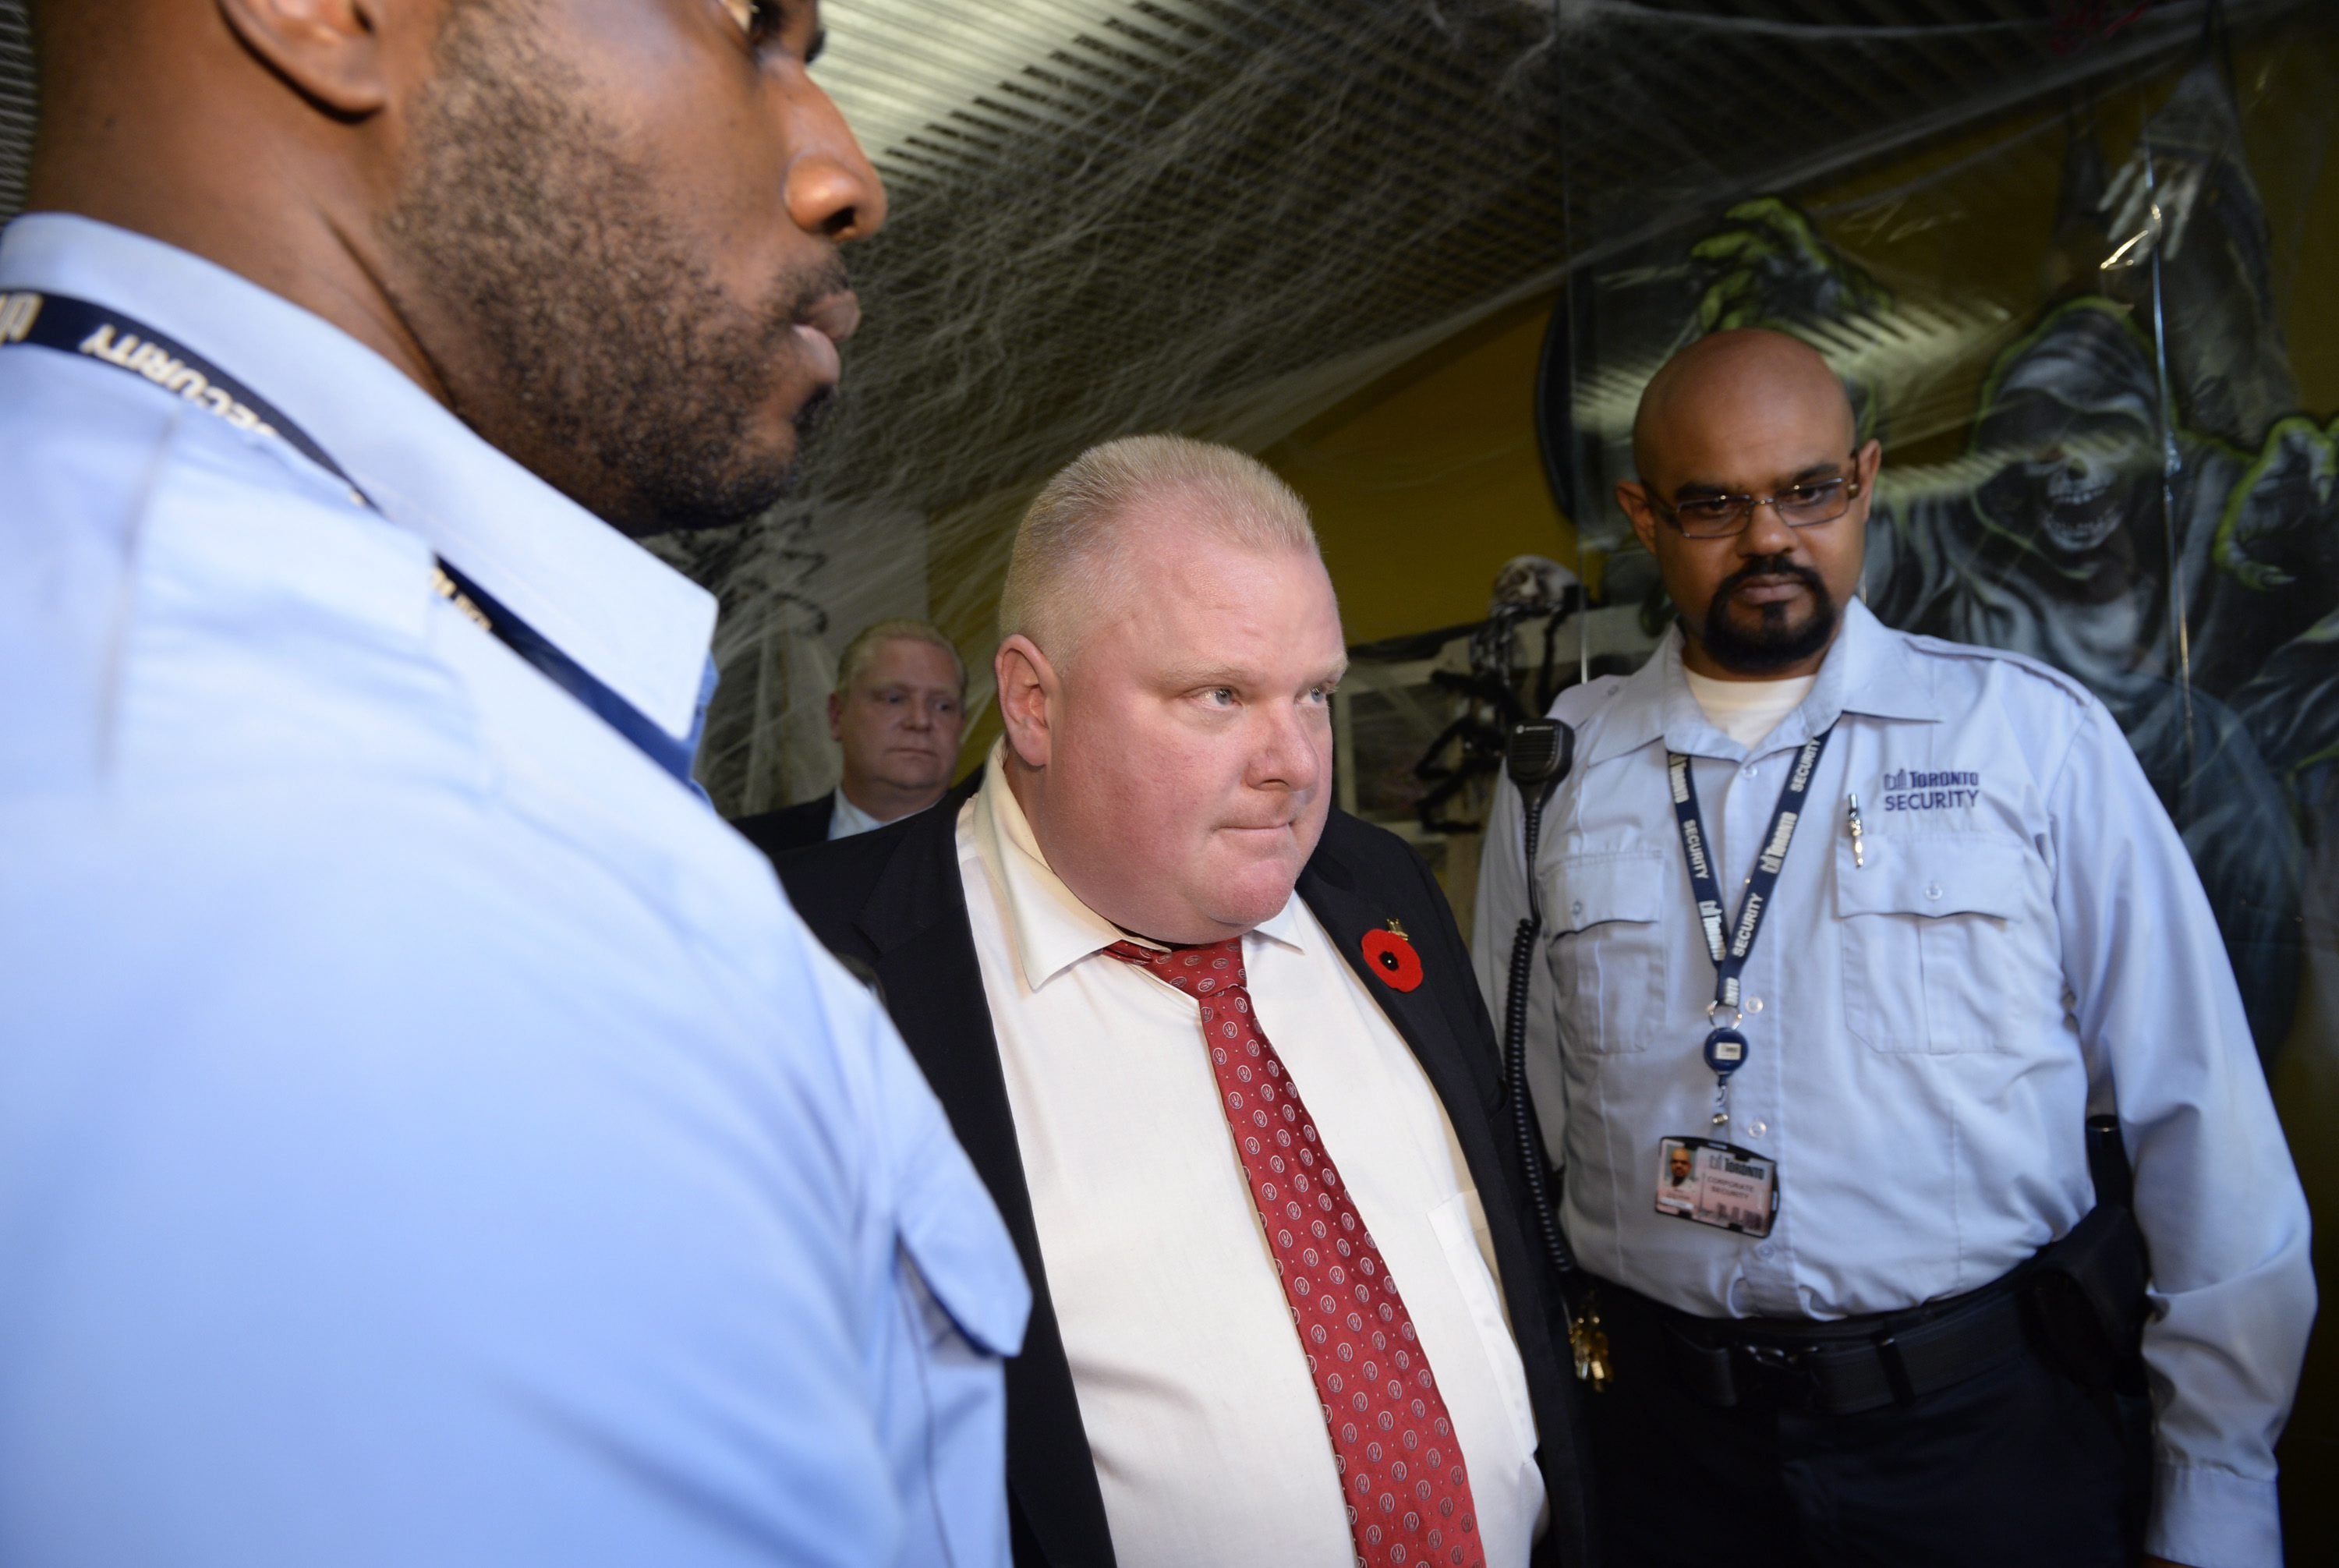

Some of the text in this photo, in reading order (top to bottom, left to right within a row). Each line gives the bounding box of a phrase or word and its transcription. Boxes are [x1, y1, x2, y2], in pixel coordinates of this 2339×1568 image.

[1909, 770, 1979, 788] TORONTO
[1884, 789, 1980, 812] SECURITY
[1683, 819, 1710, 879] SECURITY
[1732, 892, 1764, 957] SECURITY
[1764, 811, 1798, 858] TORONTO
[1789, 739, 1821, 793] SECURITY
